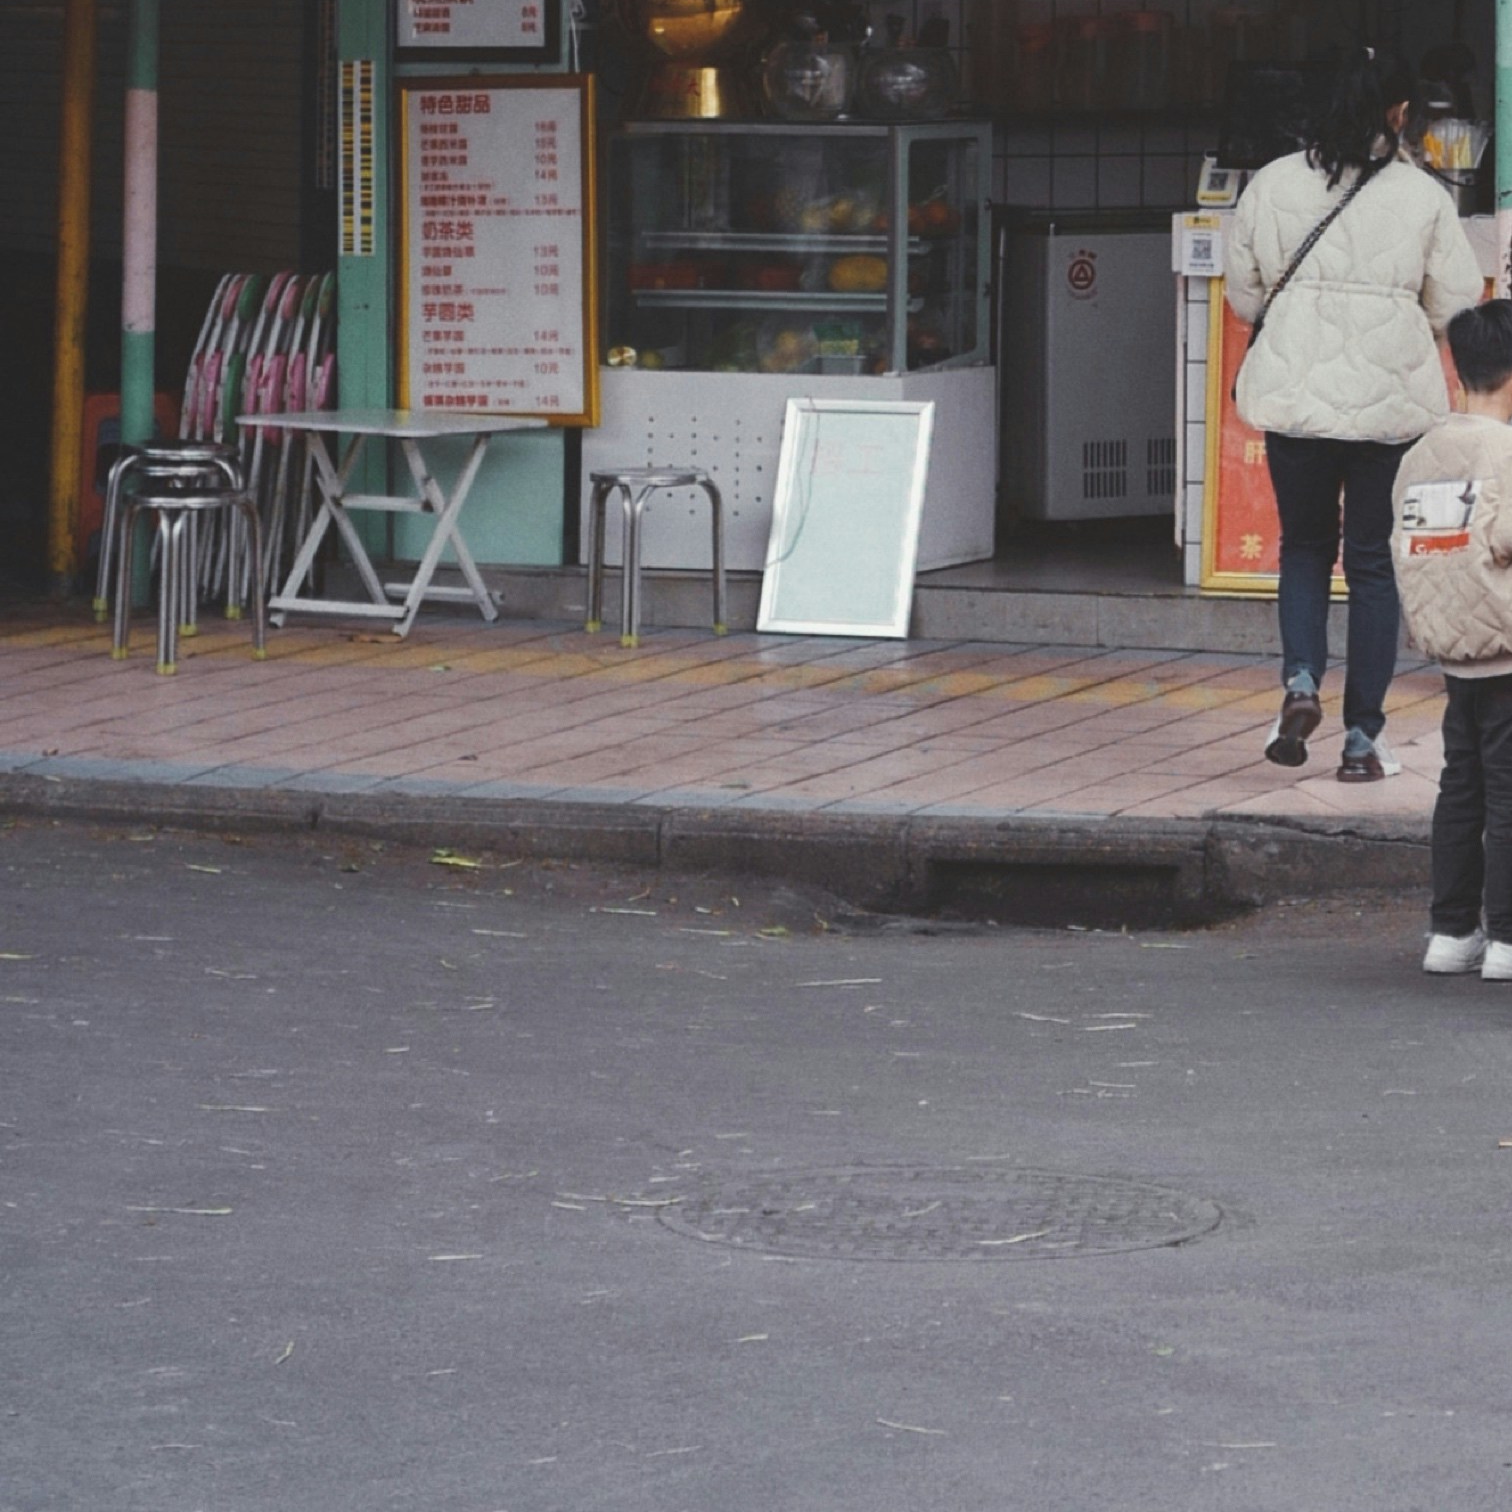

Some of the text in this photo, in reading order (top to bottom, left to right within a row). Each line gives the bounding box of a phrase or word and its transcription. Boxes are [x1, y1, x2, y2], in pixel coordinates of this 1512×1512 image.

[420, 94, 491, 114] 特色甜品
[421, 221, 474, 240] 奶茶类
[422, 303, 475, 322] 芋圆类
